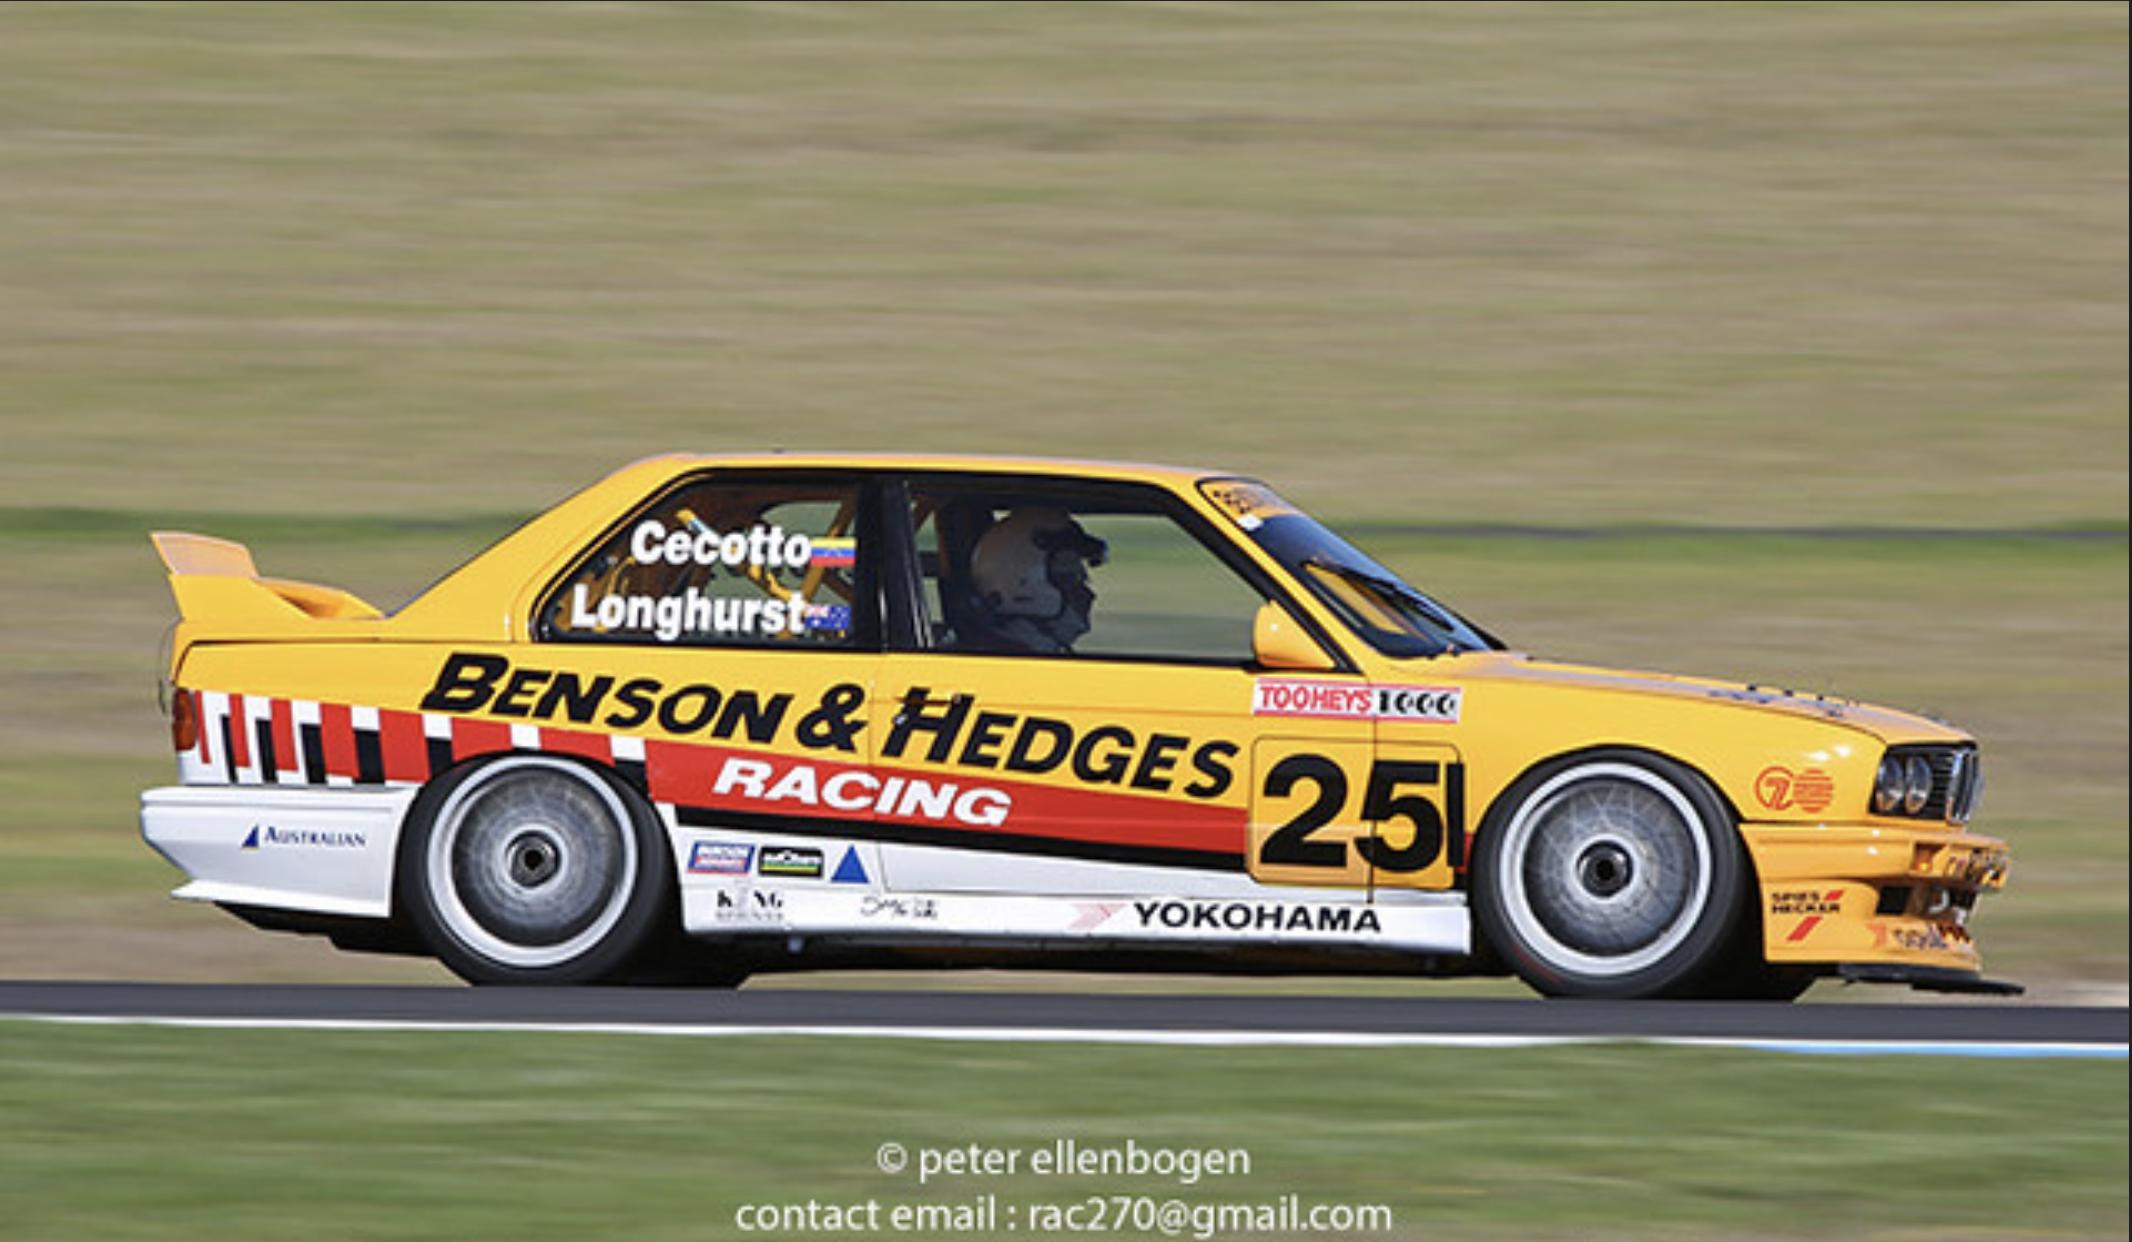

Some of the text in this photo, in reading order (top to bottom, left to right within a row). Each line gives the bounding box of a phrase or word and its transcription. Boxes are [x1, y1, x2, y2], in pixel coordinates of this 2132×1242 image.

[631, 519, 812, 567] Cecotto
[571, 584, 805, 640] Longhurst
[420, 653, 1241, 798] BENSON & HEDGES
[1260, 686, 1456, 716] TOOHEYS 1000
[712, 756, 1012, 826] RACING
[1134, 902, 1381, 933] YOKOHAMA
